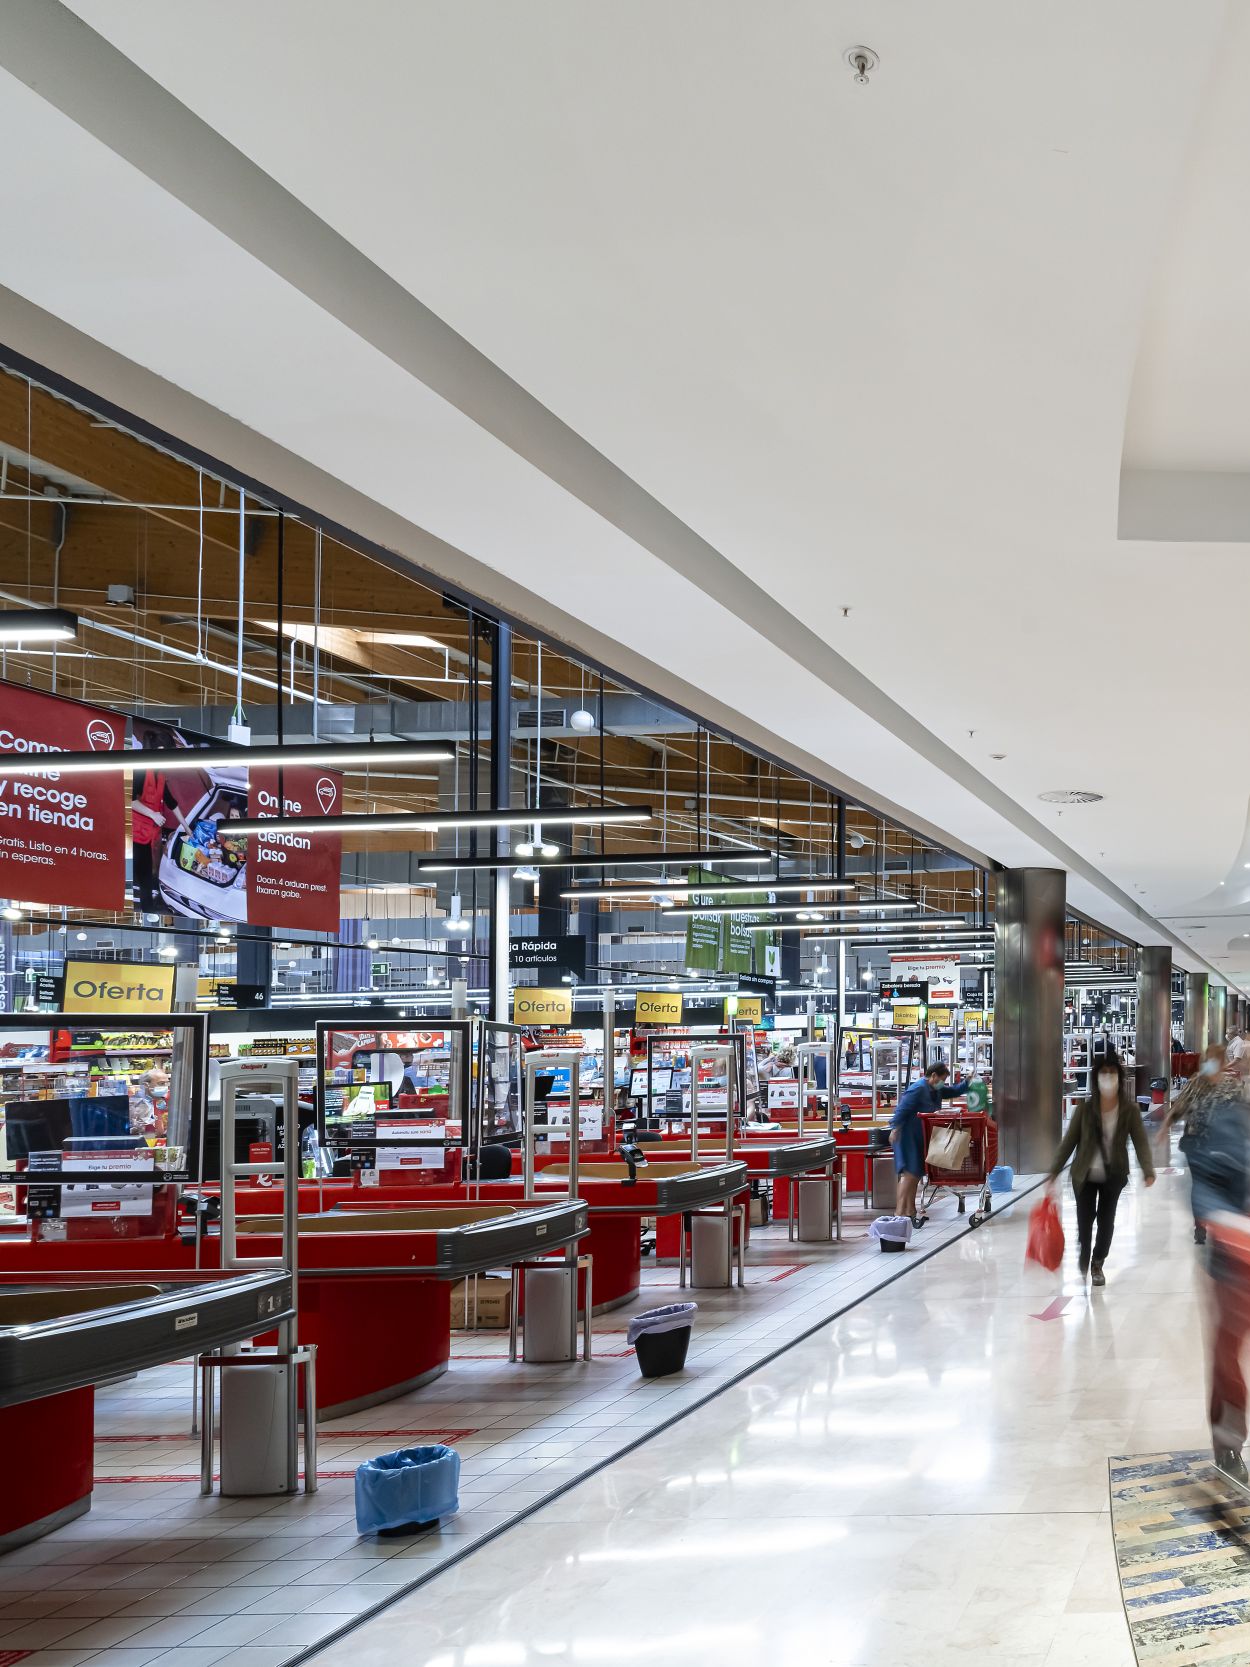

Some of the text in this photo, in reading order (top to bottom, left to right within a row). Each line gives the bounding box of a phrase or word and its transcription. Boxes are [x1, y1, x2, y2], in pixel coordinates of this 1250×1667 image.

[13, 781, 88, 811] recoge
[257, 790, 302, 813] Onine
[27, 803, 94, 832] tienda
[29, 840, 52, 852] Listo
[54, 845, 69, 855] en
[70, 848, 77, 856] 4
[79, 848, 110, 861] horas.
[256, 845, 287, 863] jaso
[0, 850, 56, 866] in esperas.
[278, 878, 284, 886] 4
[508, 941, 557, 953] ja Rápida
[514, 954, 558, 963] 10 artículos
[73, 980, 164, 1001] Oferta
[254, 992, 264, 1000] 46
[518, 1000, 566, 1012] Oferta
[639, 1002, 679, 1013] Oferta
[736, 1007, 759, 1016] erta
